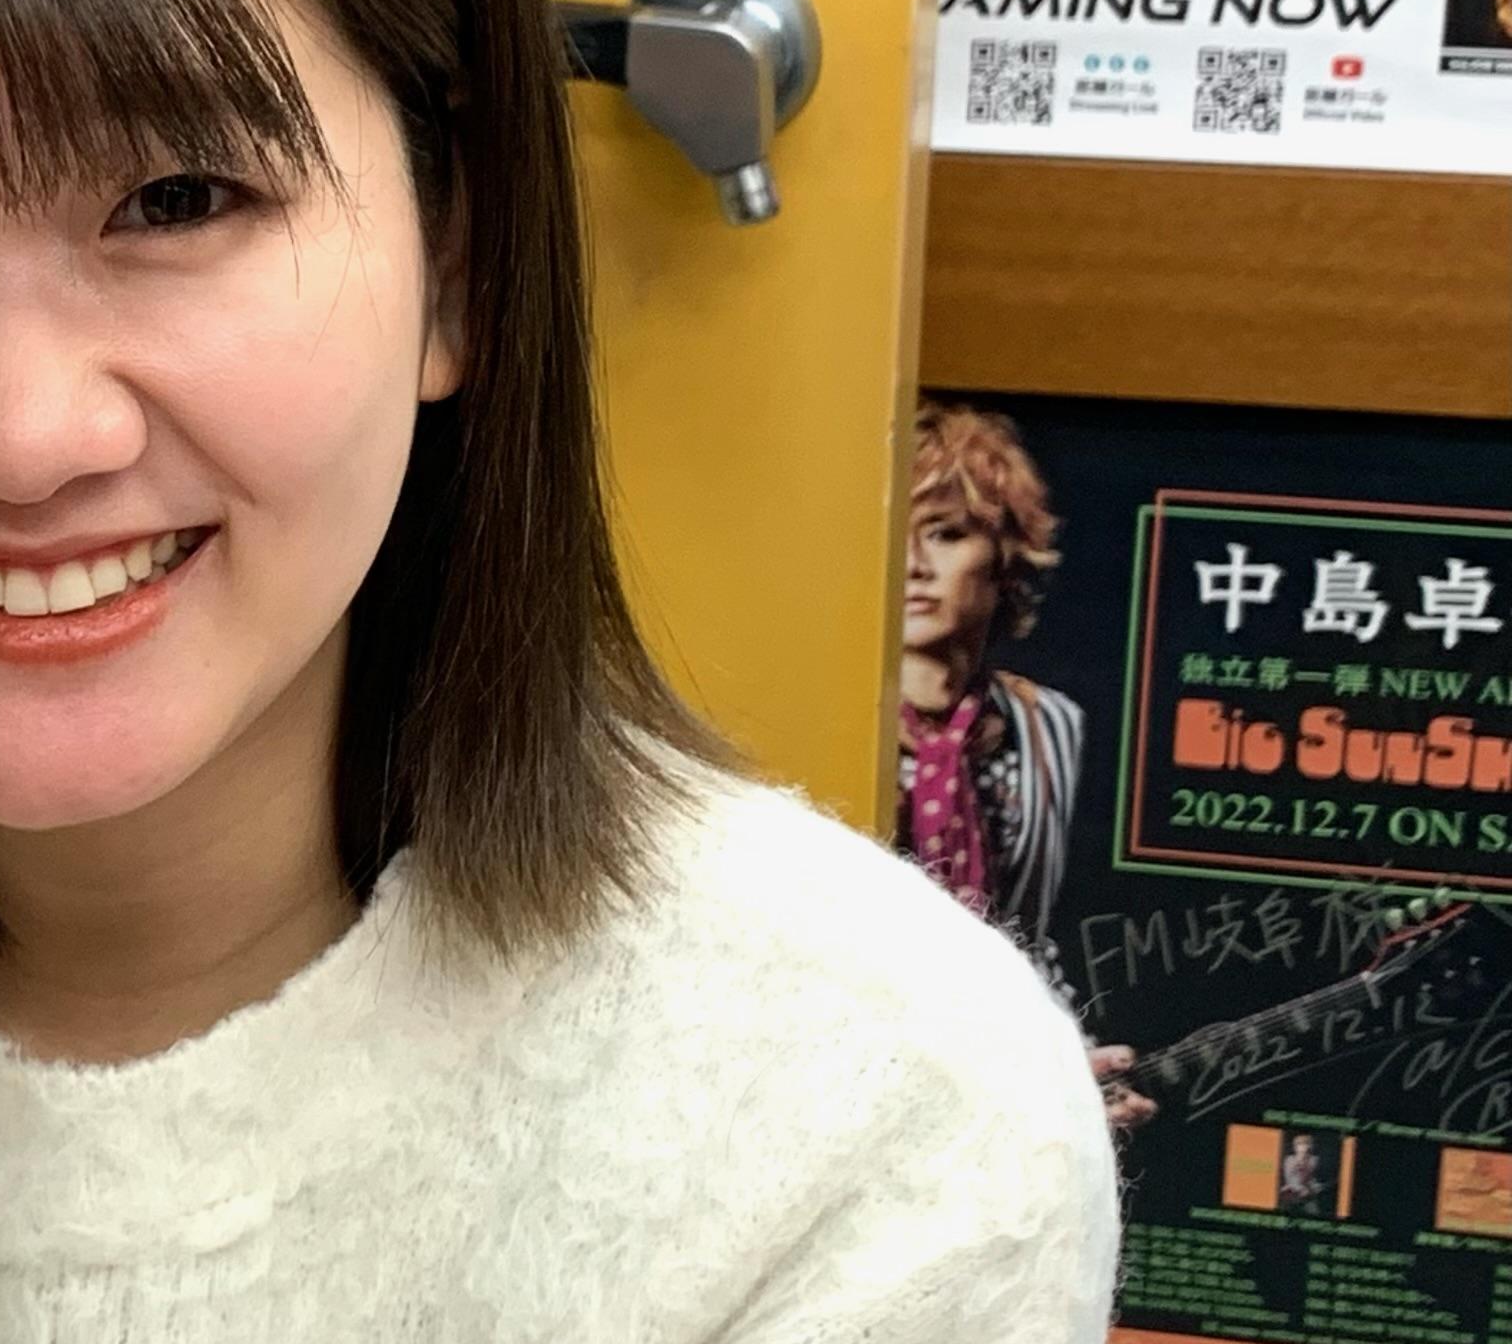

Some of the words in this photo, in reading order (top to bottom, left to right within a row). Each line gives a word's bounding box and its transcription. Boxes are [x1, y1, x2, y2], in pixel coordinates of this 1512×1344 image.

[1194, 542, 1504, 650] 中島卓
[1378, 666, 1472, 702] NEW
[1169, 789, 1380, 842] 2022.12.7
[1388, 807, 1467, 847] ON
[1477, 813, 1512, 854] S
